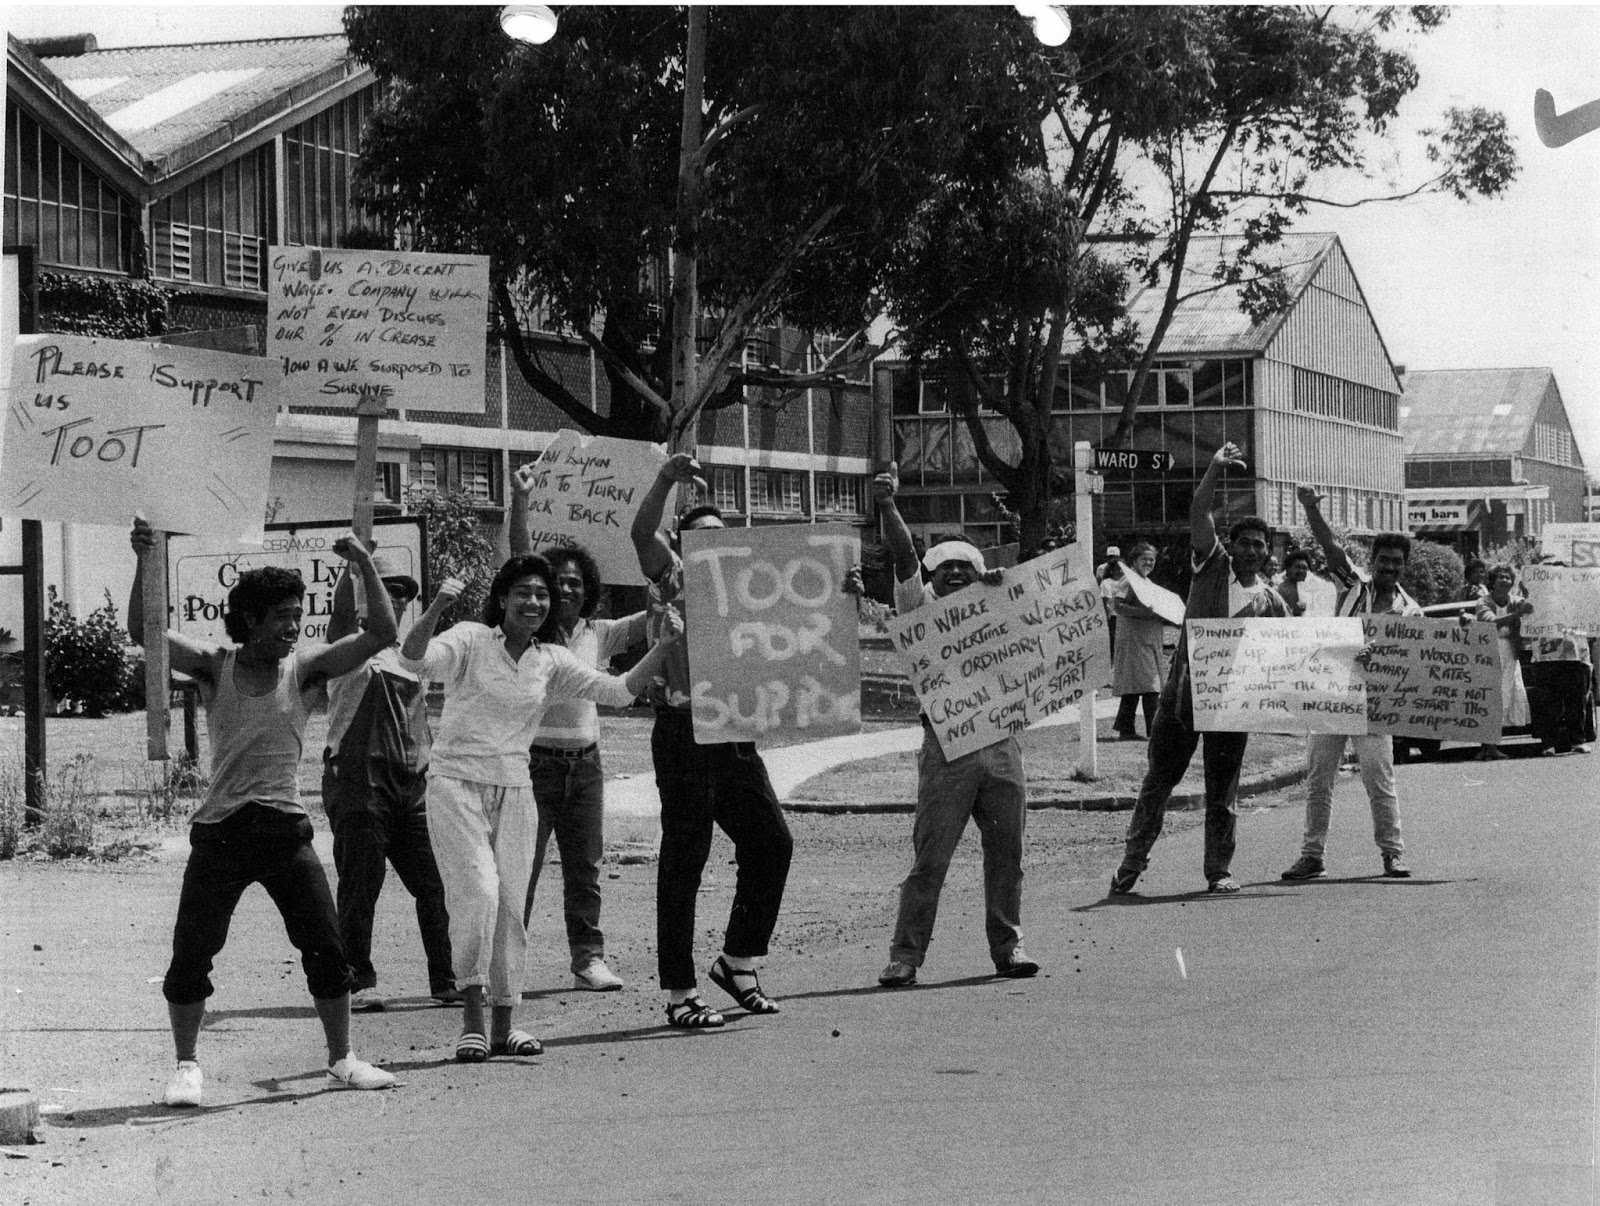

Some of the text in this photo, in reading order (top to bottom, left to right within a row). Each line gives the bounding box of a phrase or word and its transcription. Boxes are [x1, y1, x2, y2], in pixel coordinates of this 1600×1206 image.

[273, 255, 309, 281] GIVE
[323, 260, 344, 273] US
[381, 259, 476, 276] DECENT
[348, 279, 419, 313] COMPANY
[277, 306, 446, 326] NOT EVEN DISCUSS
[275, 326, 305, 340] OUR
[319, 323, 344, 346] %
[31, 345, 124, 383] PLEASE
[448, 363, 472, 378] TO
[319, 379, 394, 396] SURVIVE
[42, 416, 165, 468] TOOT
[564, 446, 611, 476] LYNN
[1098, 451, 1165, 469] WARD ST
[555, 474, 573, 492] TO
[581, 475, 635, 505] TURN
[529, 499, 620, 528] OCK BACK
[1431, 508, 1460, 519] barn
[262, 537, 326, 551] CERAMCO
[531, 530, 577, 551] YEARS
[688, 534, 862, 618] TOOT
[1523, 566, 1563, 581] CROWN
[899, 558, 1078, 651] NO WHERE IN NZ
[730, 613, 848, 666] FOR
[912, 589, 1098, 673] IS OVERTIME WORKED
[1385, 621, 1425, 640] WHERE
[1433, 630, 1448, 640] IN
[1452, 627, 1471, 645] NZ
[1478, 634, 1491, 645] IS
[961, 634, 1046, 678] ORDINARY
[1047, 613, 1104, 645] RATES
[1193, 646, 1232, 665] GONE
[1244, 649, 1267, 664] UP
[1420, 647, 1469, 665] WORKED
[1475, 654, 1494, 667] FOR
[1195, 669, 1209, 678] IN
[1218, 665, 1248, 677] LAST
[1425, 664, 1473, 683] RATES
[930, 646, 1085, 725] CROWN LYNN ARE
[1244, 681, 1285, 693] WANT
[1289, 680, 1316, 692] THE
[1432, 685, 1458, 698] ARE
[1465, 687, 1493, 700] NOT
[947, 653, 1095, 742] NOT GOING TO START
[1194, 699, 1236, 711] JUST
[1240, 701, 1250, 710] A
[1258, 698, 1289, 713] FAIR
[1302, 701, 1365, 715] INCREASE
[1388, 697, 1407, 708] TO
[1412, 698, 1455, 711] START
[1462, 702, 1489, 717] THIS
[1003, 688, 1084, 737] THIS TREND
